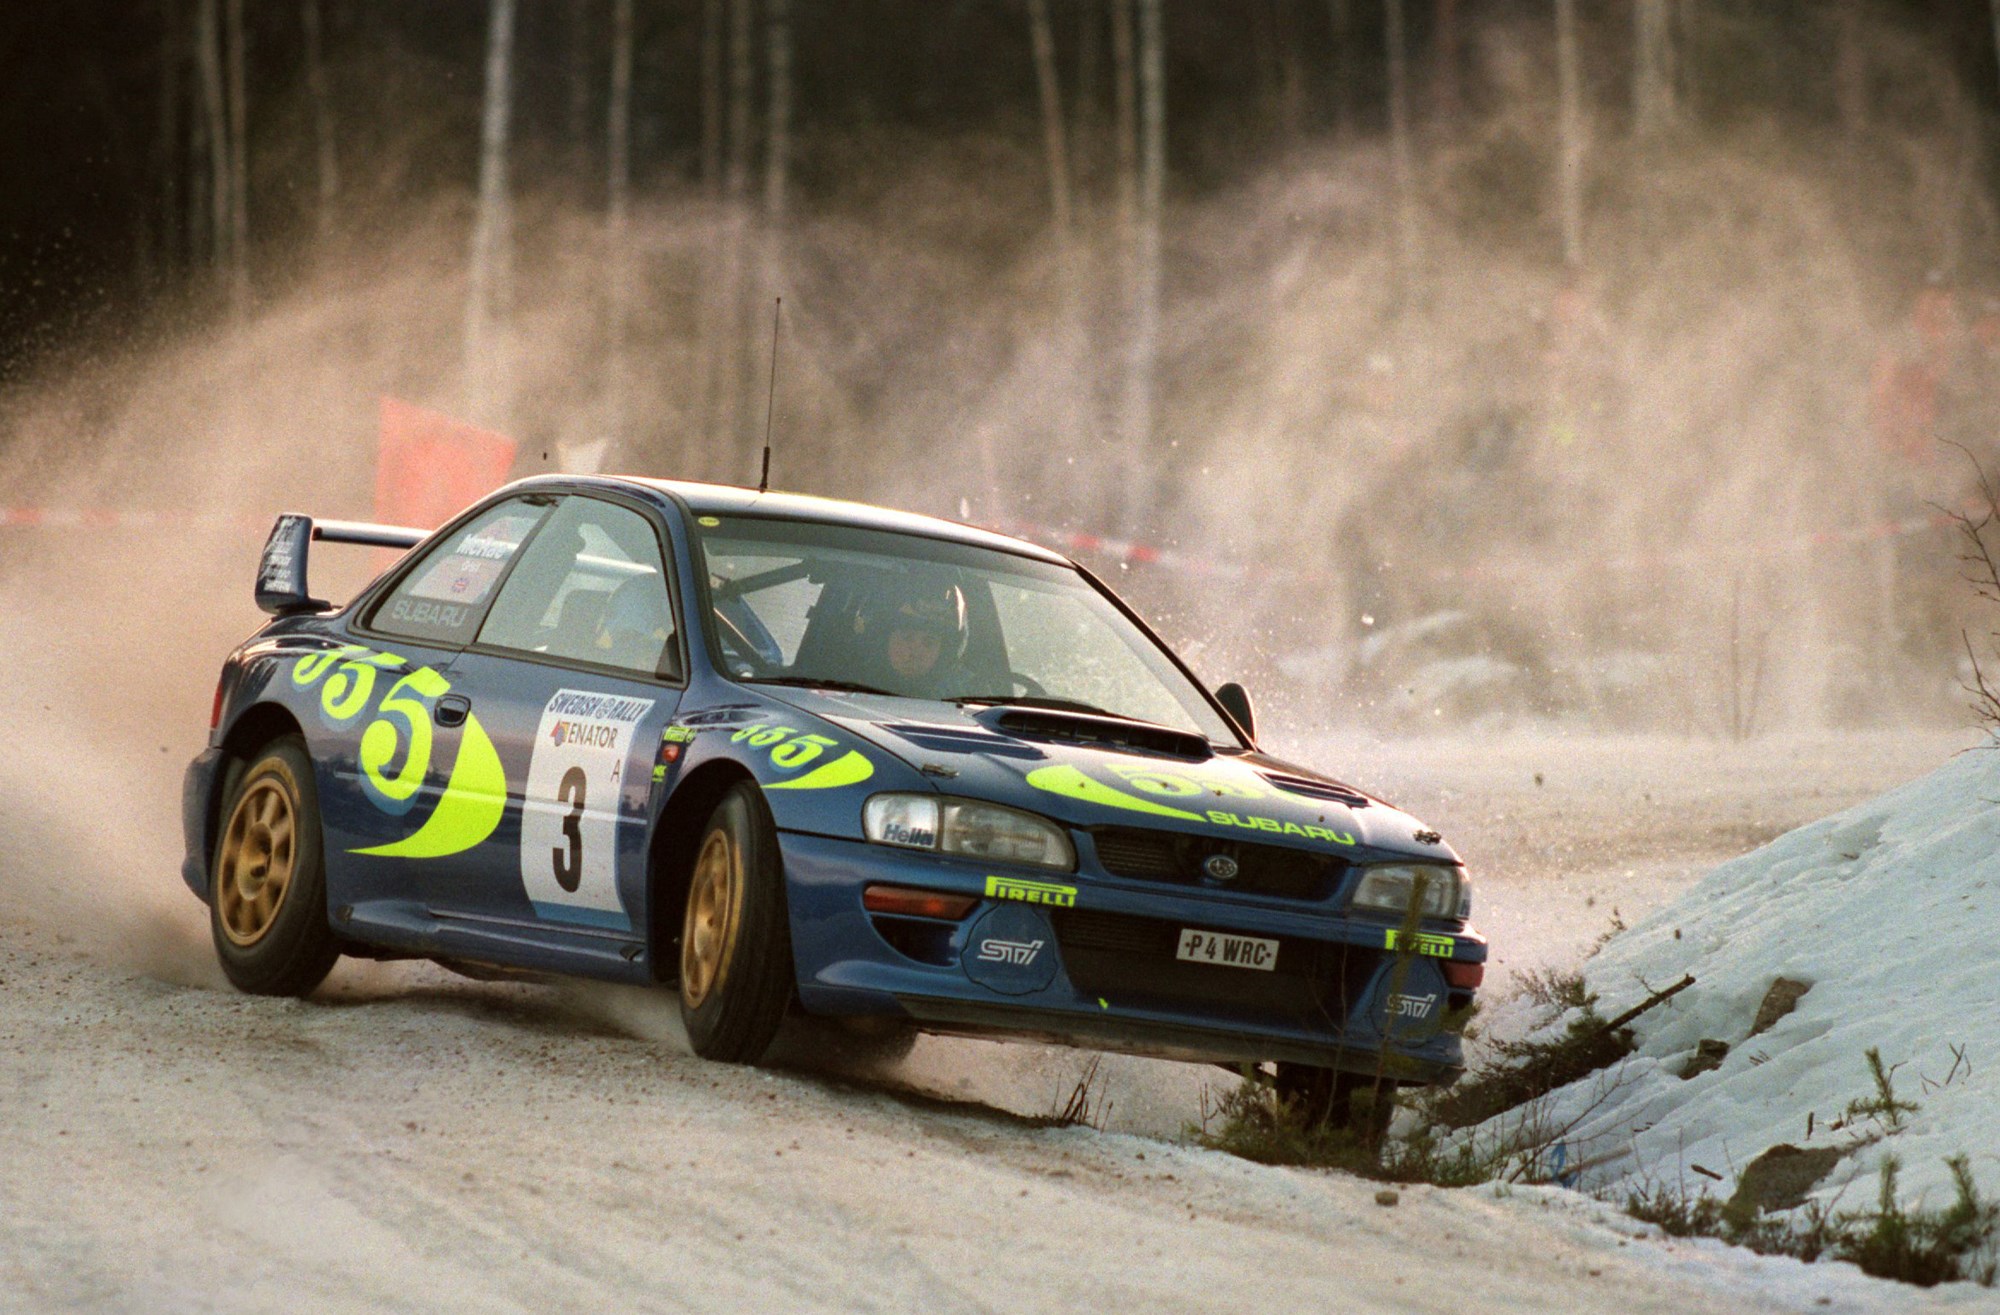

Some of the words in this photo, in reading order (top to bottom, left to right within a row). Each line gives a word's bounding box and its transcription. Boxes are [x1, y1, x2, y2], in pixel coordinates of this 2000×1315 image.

[391, 601, 469, 627] SUBARU
[549, 693, 603, 717] SWEDISH
[608, 700, 649, 722] RALLY
[292, 645, 451, 800] 555
[568, 721, 618, 748] ENATOR
[731, 724, 839, 768] 555
[611, 759, 620, 783] A
[553, 766, 587, 893] 3
[883, 823, 934, 847] Hella
[1206, 810, 1355, 845] SUBARU
[985, 876, 1078, 908] PIRELLI
[1223, 938, 1267, 965] WRC
[1385, 929, 1456, 958] PELLI
